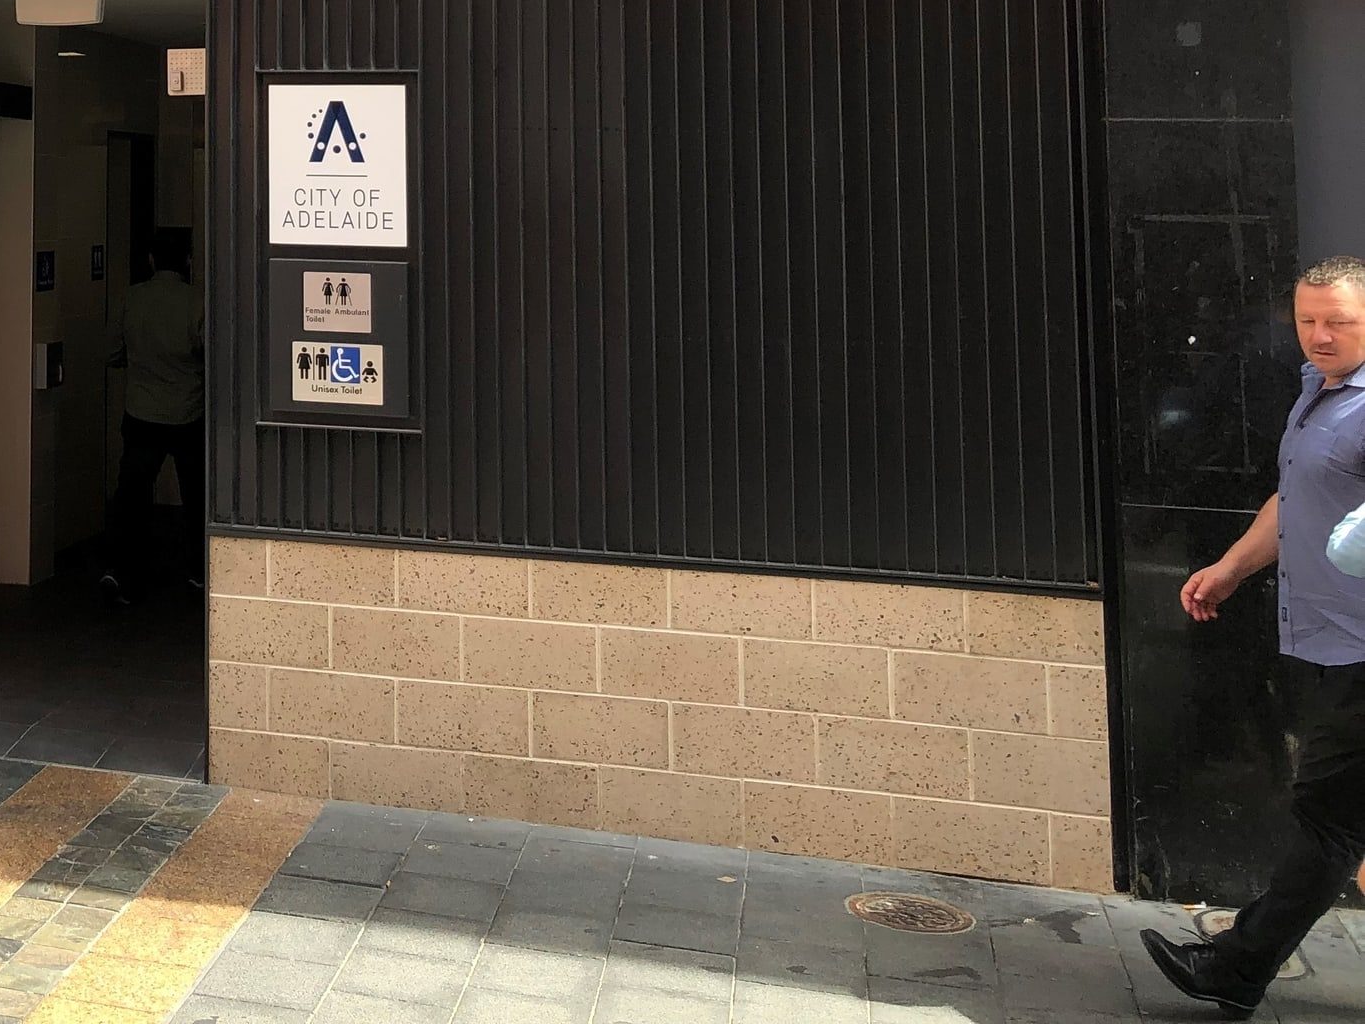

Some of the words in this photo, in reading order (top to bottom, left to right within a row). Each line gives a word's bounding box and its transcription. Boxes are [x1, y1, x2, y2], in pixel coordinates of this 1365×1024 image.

[294, 188, 342, 207] CITY
[353, 189, 381, 208] OF
[282, 210, 394, 230] ADELAIDE
[305, 307, 331, 315] Female
[334, 307, 370, 317] Ambulant
[311, 384, 339, 395] Unisex
[340, 385, 363, 396] Toilet
